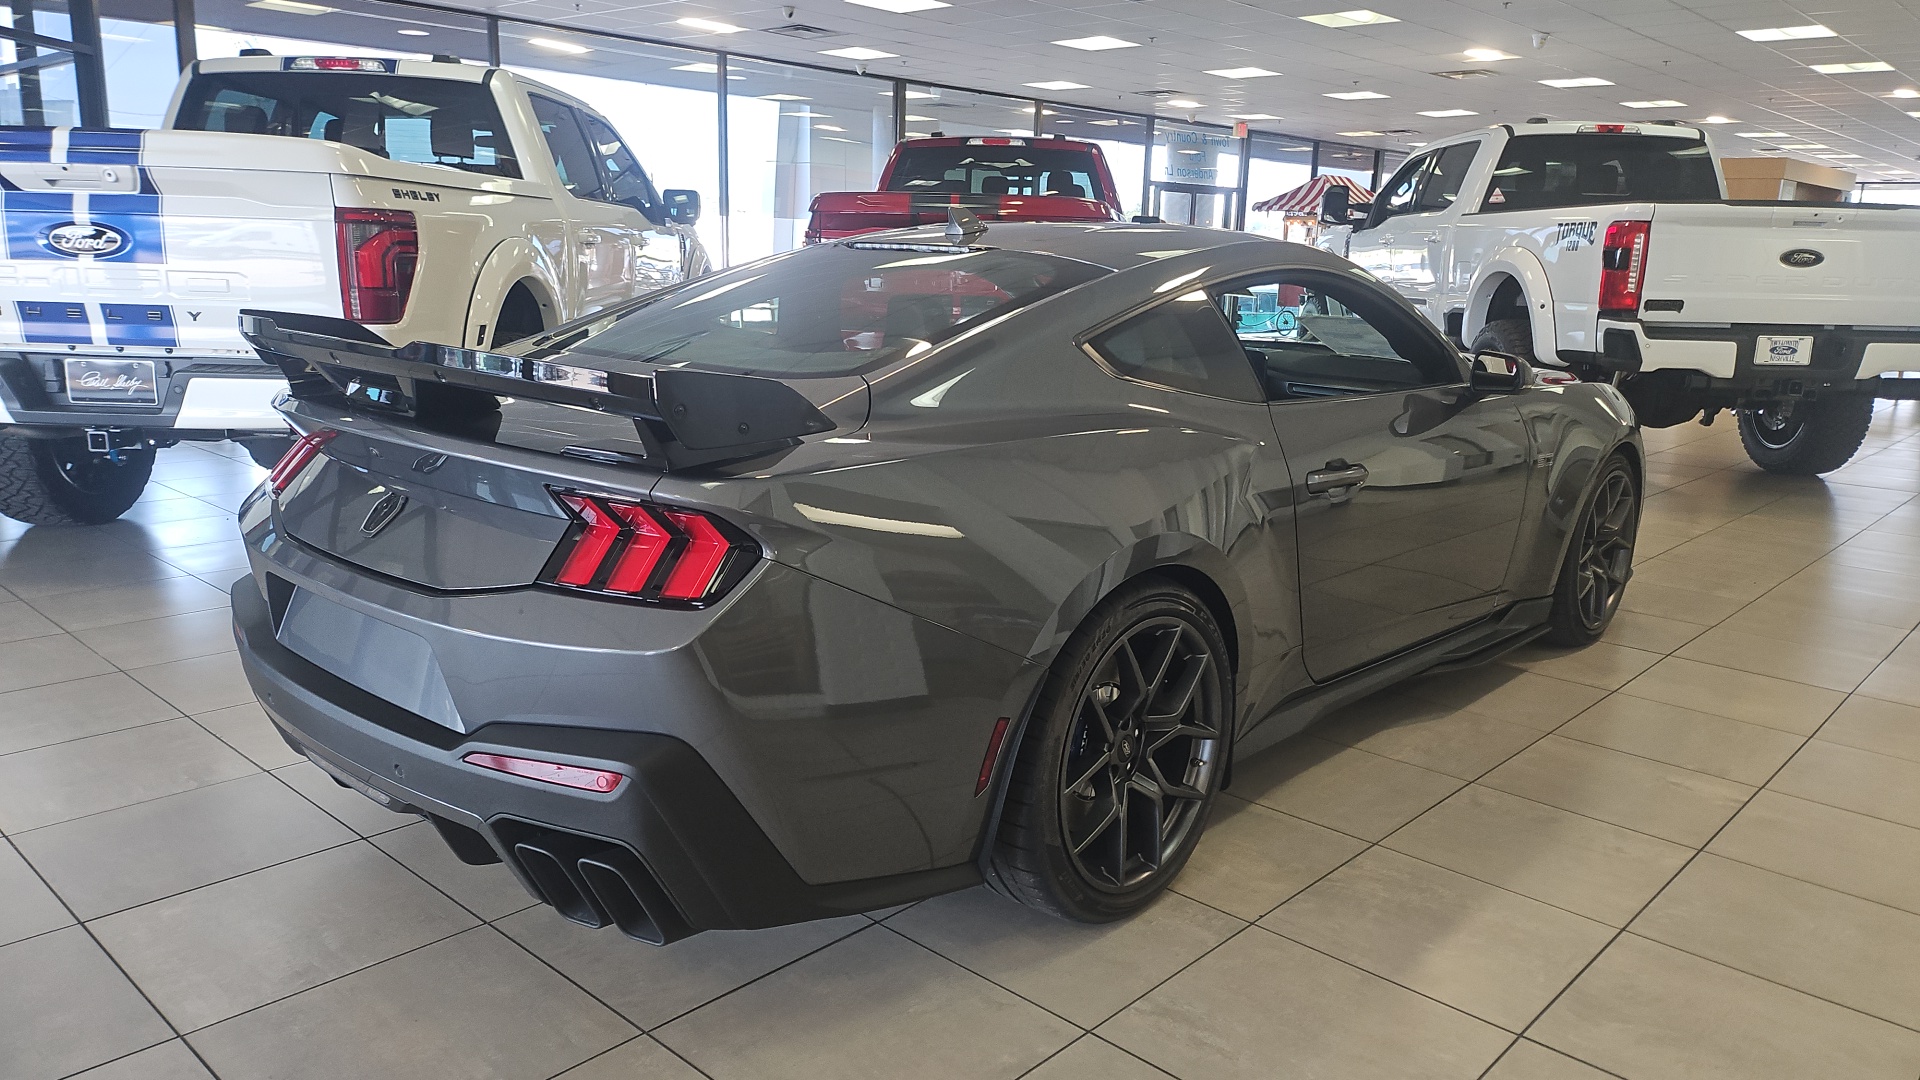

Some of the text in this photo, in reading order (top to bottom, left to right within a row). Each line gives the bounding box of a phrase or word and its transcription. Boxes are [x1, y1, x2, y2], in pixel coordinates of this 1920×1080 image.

[391, 188, 441, 202] SHELBY
[60, 230, 108, 250] Ford
[1555, 221, 1598, 246] TORQUE
[1790, 252, 1816, 264] Ford
[0, 305, 202, 324] HELBY
